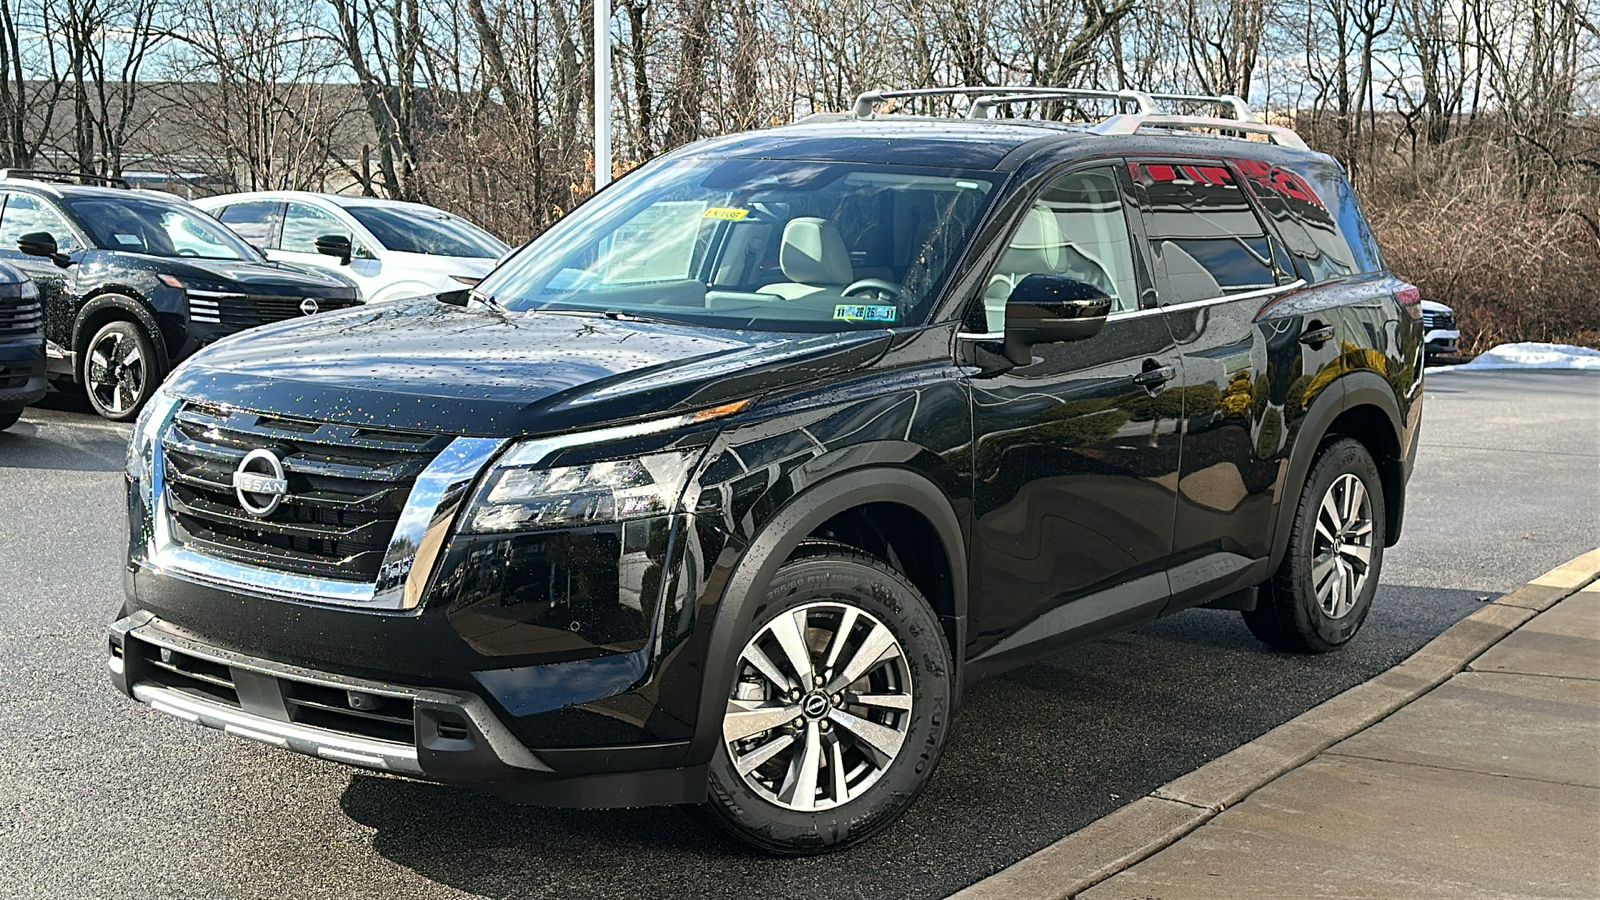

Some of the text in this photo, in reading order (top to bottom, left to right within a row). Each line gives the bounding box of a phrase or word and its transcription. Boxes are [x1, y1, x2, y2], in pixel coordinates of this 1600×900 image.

[837, 308, 845, 317] 11
[886, 309, 894, 319] 11
[914, 695, 944, 775] KUMHO
